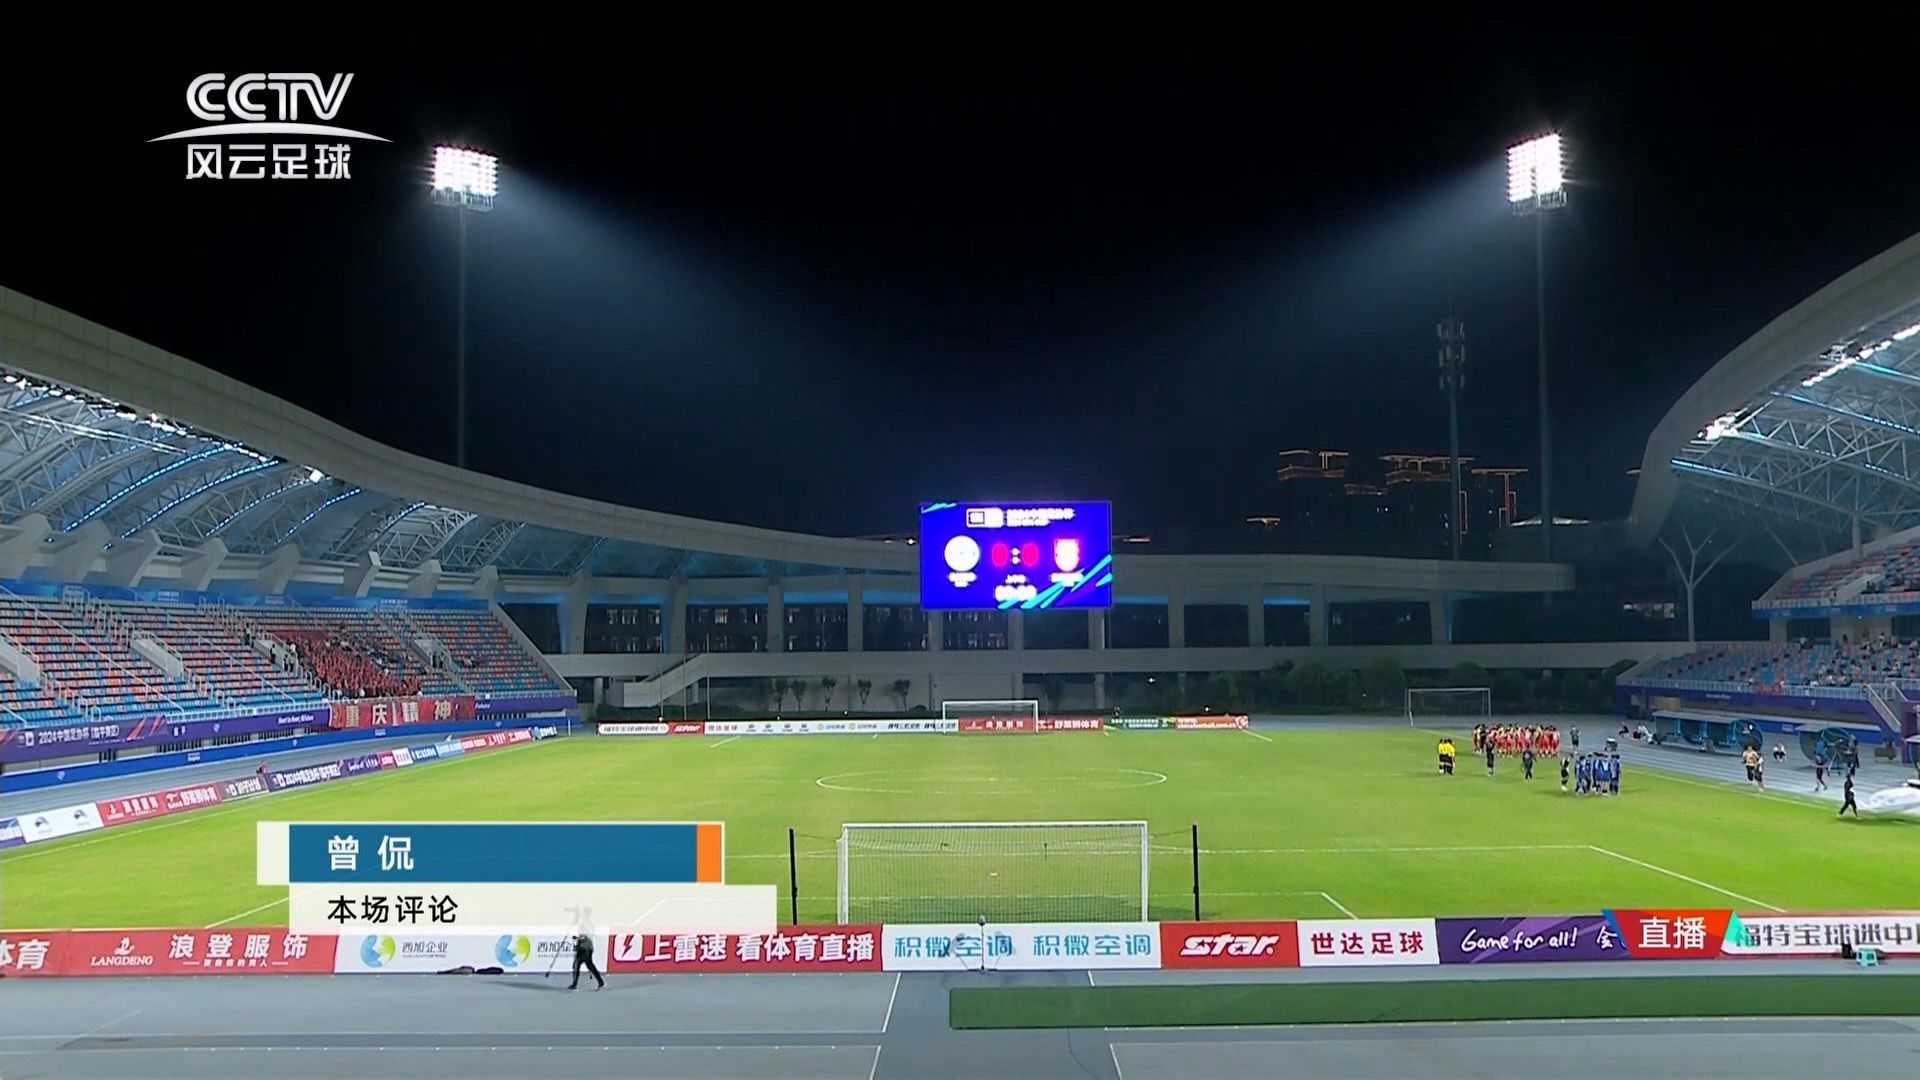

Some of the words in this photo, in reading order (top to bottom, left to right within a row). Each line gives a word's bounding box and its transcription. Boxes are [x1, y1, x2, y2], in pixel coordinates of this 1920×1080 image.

[169, 934, 309, 959] 浪登服饰
[894, 936, 1013, 958] 积微空调
[1033, 934, 1151, 957] 积微空调
[1311, 932, 1424, 955] 世达足球
[1461, 929, 1509, 951] Game
[1512, 932, 1543, 951] for
[1549, 927, 1577, 948] all!
[1596, 925, 1626, 949] 金
[1736, 923, 1920, 947] 福特宝球迷中
[644, 935, 727, 962] 上雷速
[736, 933, 874, 962] 看体育直播
[90, 955, 154, 967] LANGDENG
